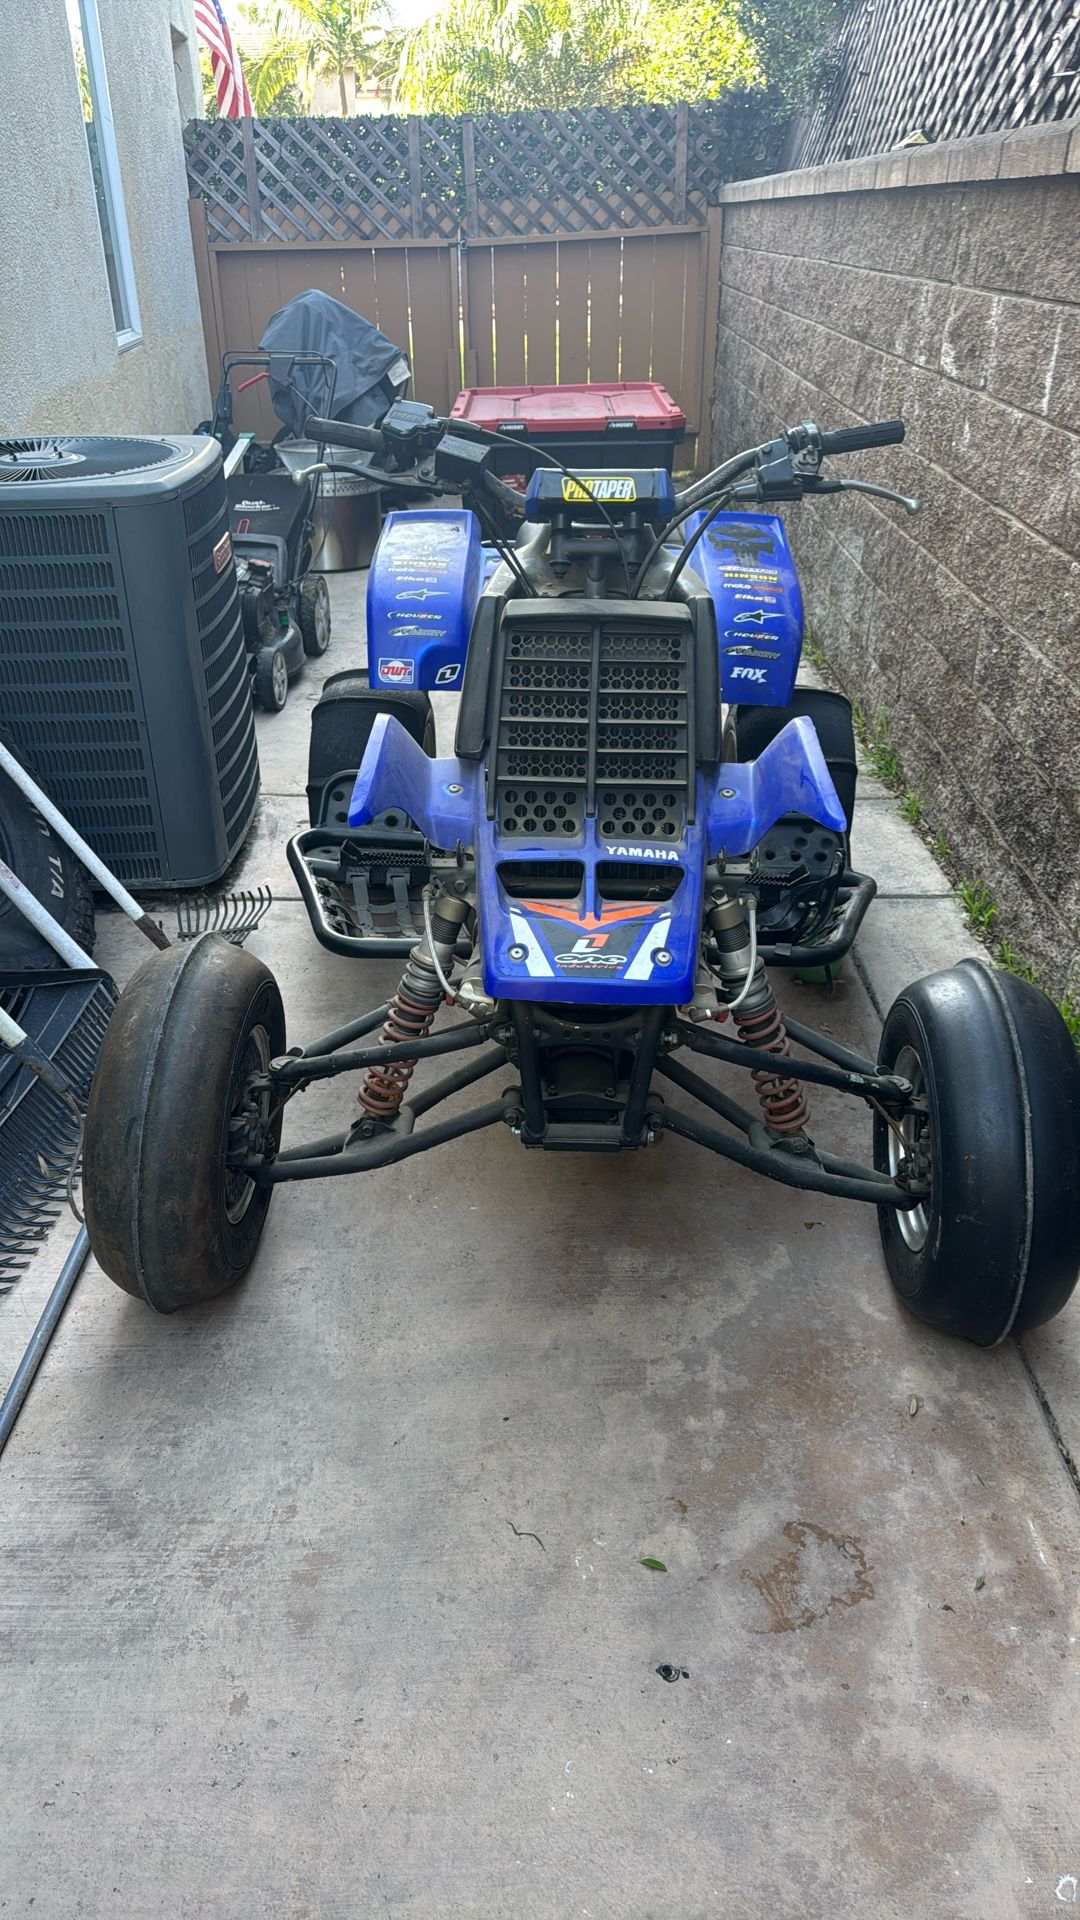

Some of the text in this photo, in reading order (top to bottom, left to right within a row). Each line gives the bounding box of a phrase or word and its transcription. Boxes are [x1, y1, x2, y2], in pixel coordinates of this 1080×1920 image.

[564, 480, 633, 499] PROTAPER
[381, 668, 412, 677] DWT
[730, 667, 768, 683] FOX
[606, 846, 679, 860] YAMAHA
[48, 856, 64, 898] T/A
